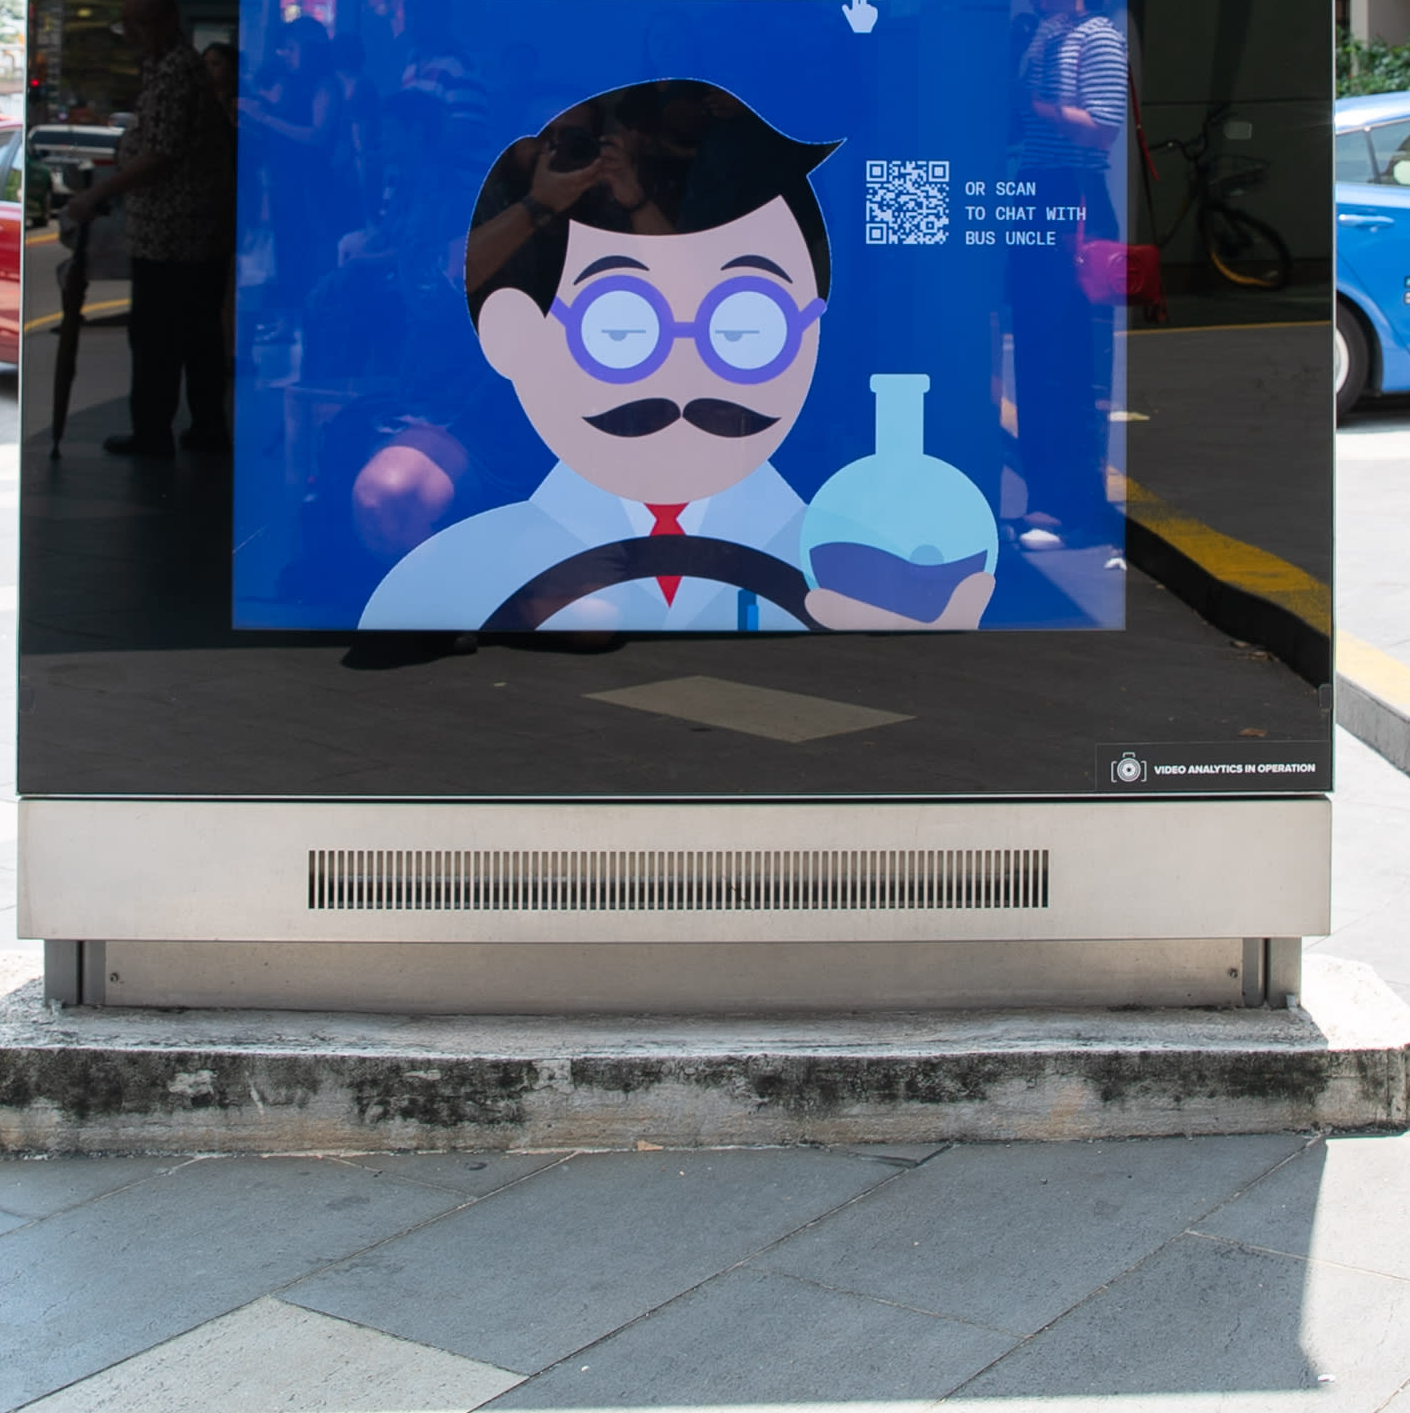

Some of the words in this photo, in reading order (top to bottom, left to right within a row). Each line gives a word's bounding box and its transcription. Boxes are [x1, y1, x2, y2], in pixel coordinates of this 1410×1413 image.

[965, 181, 988, 197] OR
[995, 181, 1037, 197] SCAN
[965, 206, 987, 222] TO
[995, 206, 1037, 222] CHAT
[1045, 206, 1087, 222] WITH
[965, 231, 996, 247] BUS
[1005, 231, 1057, 247] UNCLE
[1154, 765, 1187, 775] VIDEO
[1188, 764, 1243, 775] ANALYTICS
[1244, 764, 1256, 774] IN
[1257, 763, 1316, 774] OPERATION
